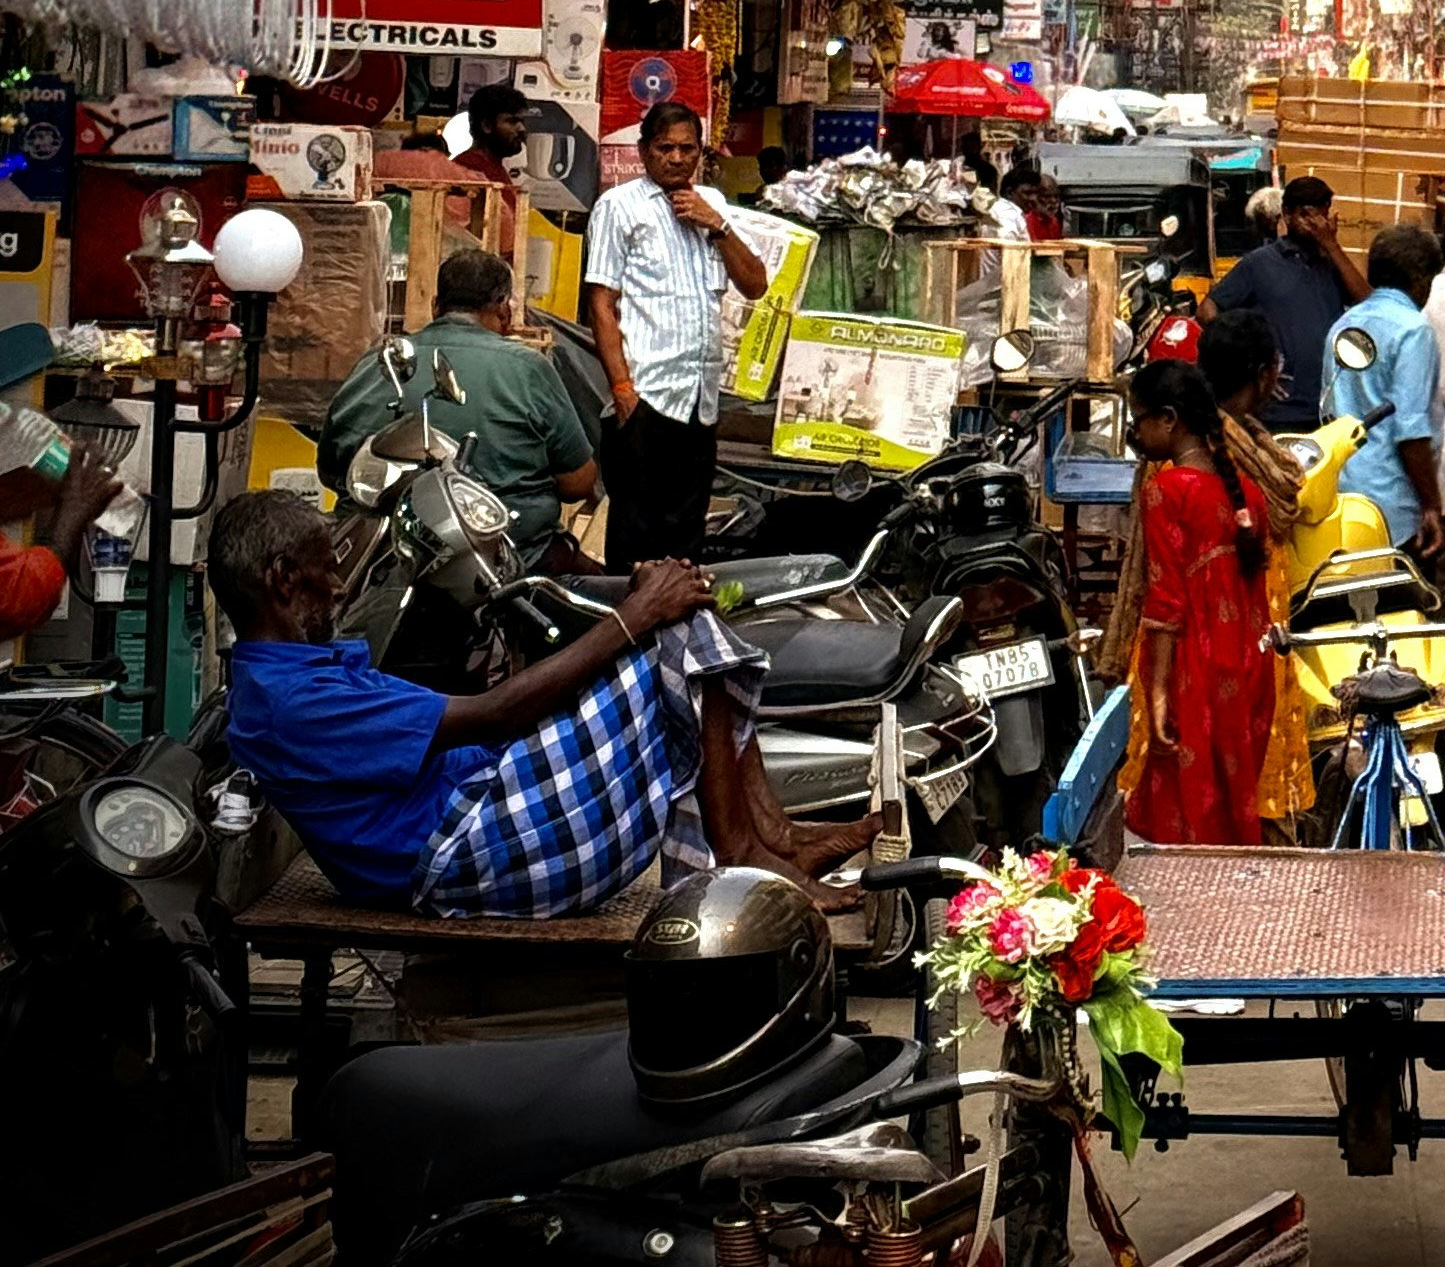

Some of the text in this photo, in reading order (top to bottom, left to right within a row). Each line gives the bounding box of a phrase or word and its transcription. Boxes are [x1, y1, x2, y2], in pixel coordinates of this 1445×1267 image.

[317, 82, 380, 113] VELLS
[831, 325, 946, 352] ALMONARD
[984, 645, 1029, 671] TN85
